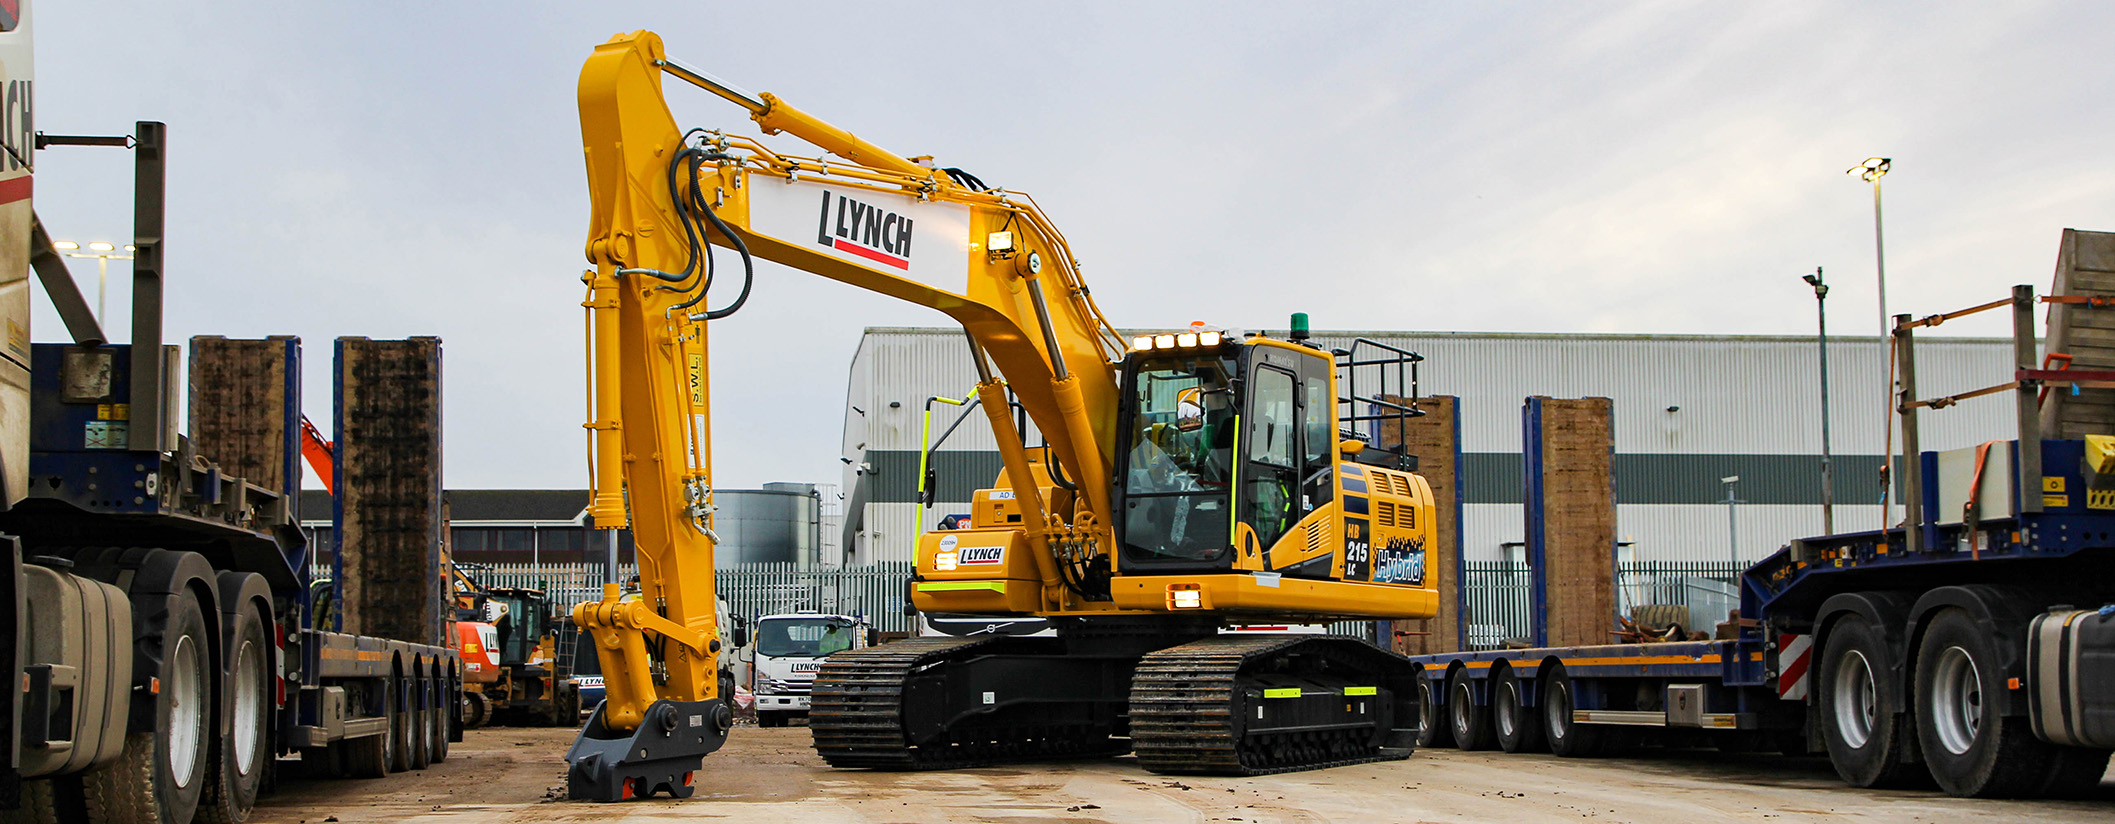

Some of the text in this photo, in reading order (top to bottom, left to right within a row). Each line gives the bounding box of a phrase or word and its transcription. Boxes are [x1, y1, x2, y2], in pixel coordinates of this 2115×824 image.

[1347, 523, 1360, 539] HB
[1347, 541, 1368, 562] 215
[1347, 563, 1356, 576] LC
[1376, 549, 1422, 583] Hybrid
